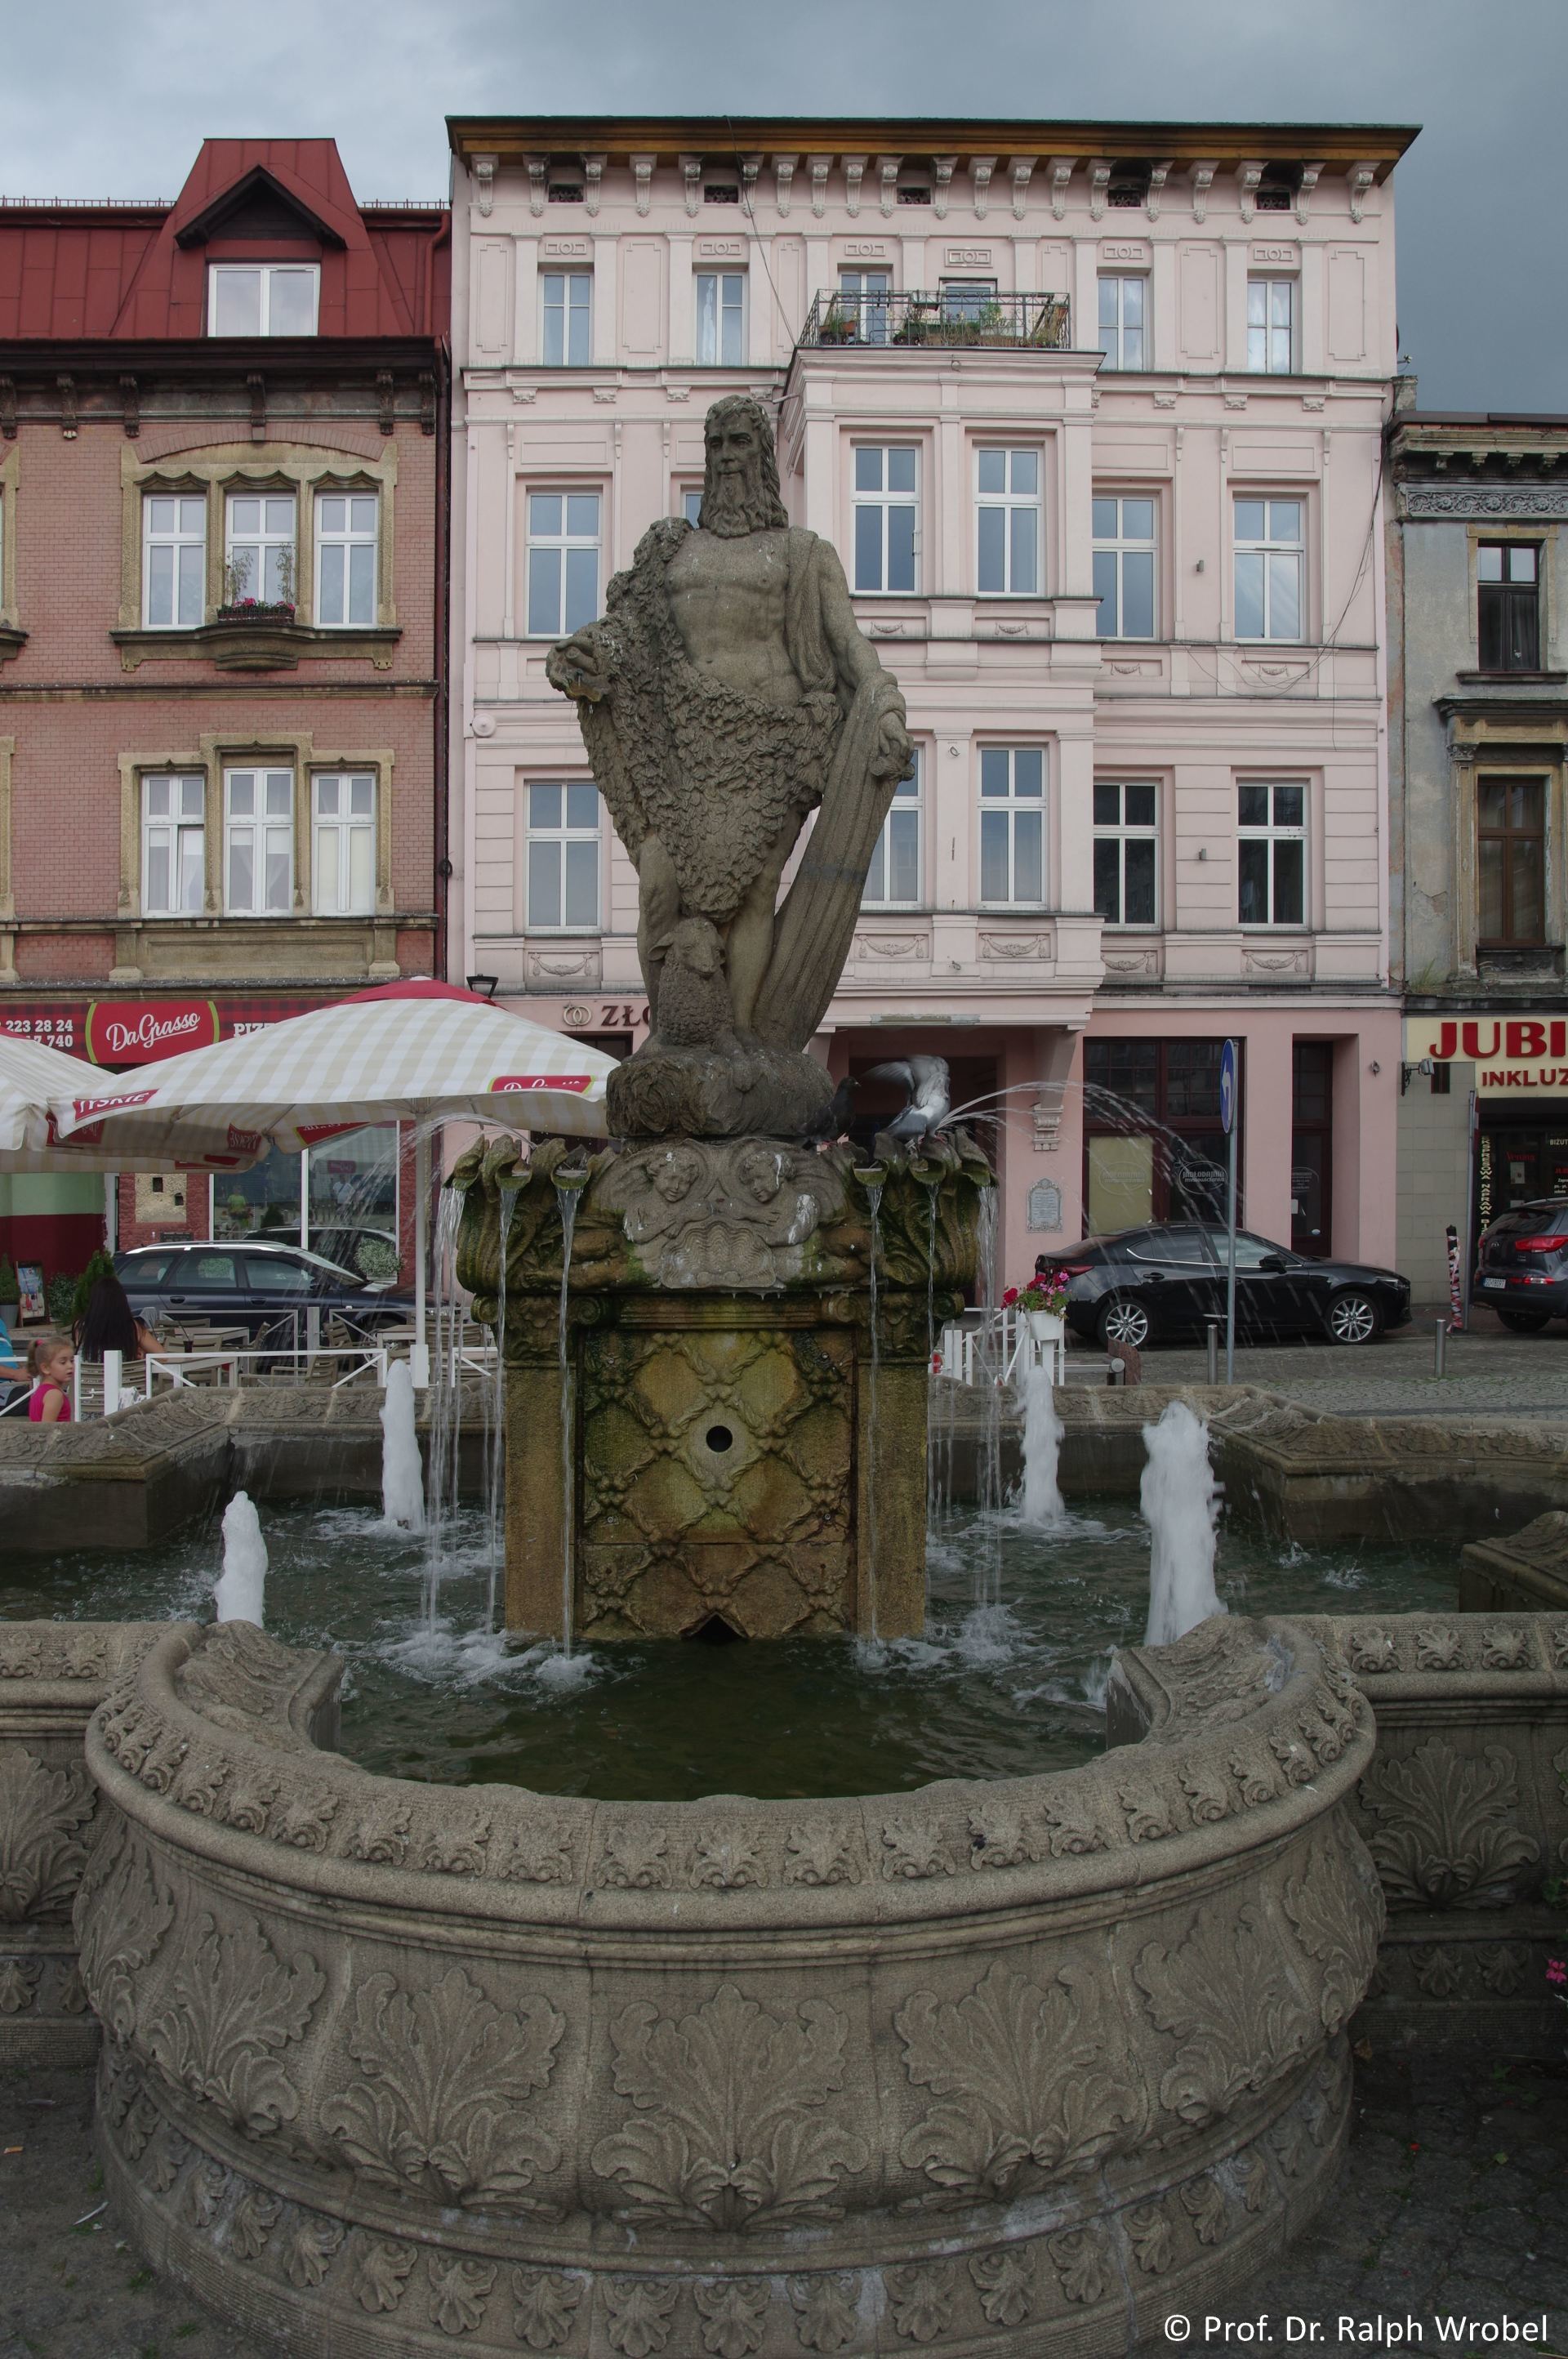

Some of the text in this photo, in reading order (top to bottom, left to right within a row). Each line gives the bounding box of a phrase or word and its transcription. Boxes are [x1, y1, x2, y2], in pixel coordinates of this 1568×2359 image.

[6, 1019, 74, 1032] 223 28 24
[233, 1023, 275, 1037] PIZ
[47, 1034, 74, 1047] 740
[1429, 1021, 1566, 1059] JUBI
[1479, 1183, 1493, 1215] NAPRAWA
